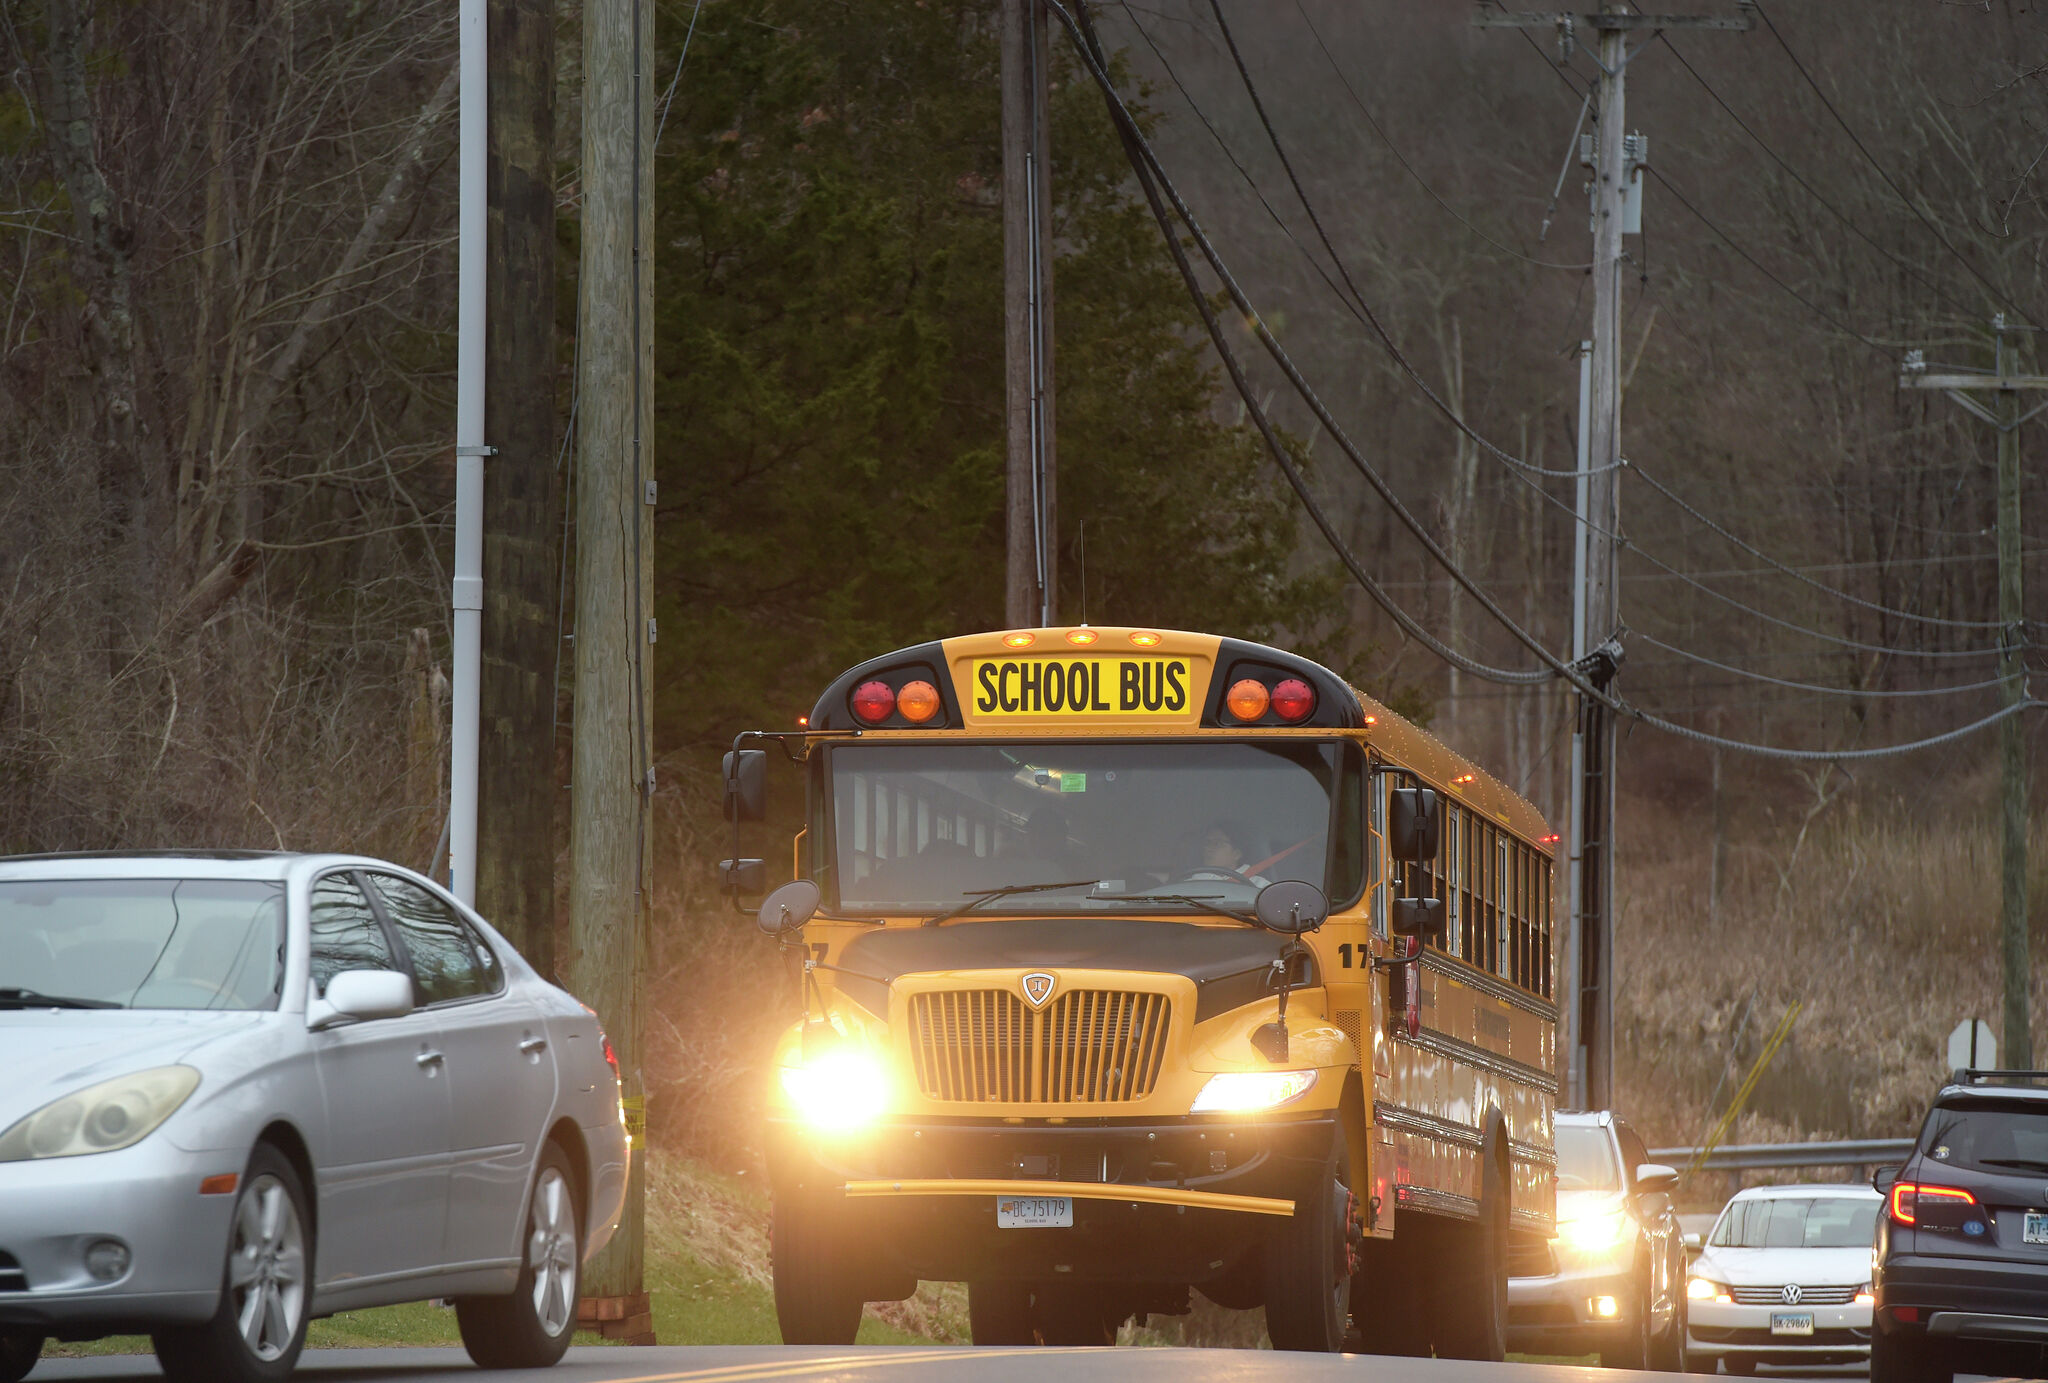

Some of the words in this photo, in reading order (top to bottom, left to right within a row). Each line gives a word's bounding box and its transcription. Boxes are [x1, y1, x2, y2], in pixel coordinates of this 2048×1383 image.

[977, 662, 1110, 712] SCHOOL
[1119, 661, 1186, 711] BUS
[1338, 943, 1368, 968] 17
